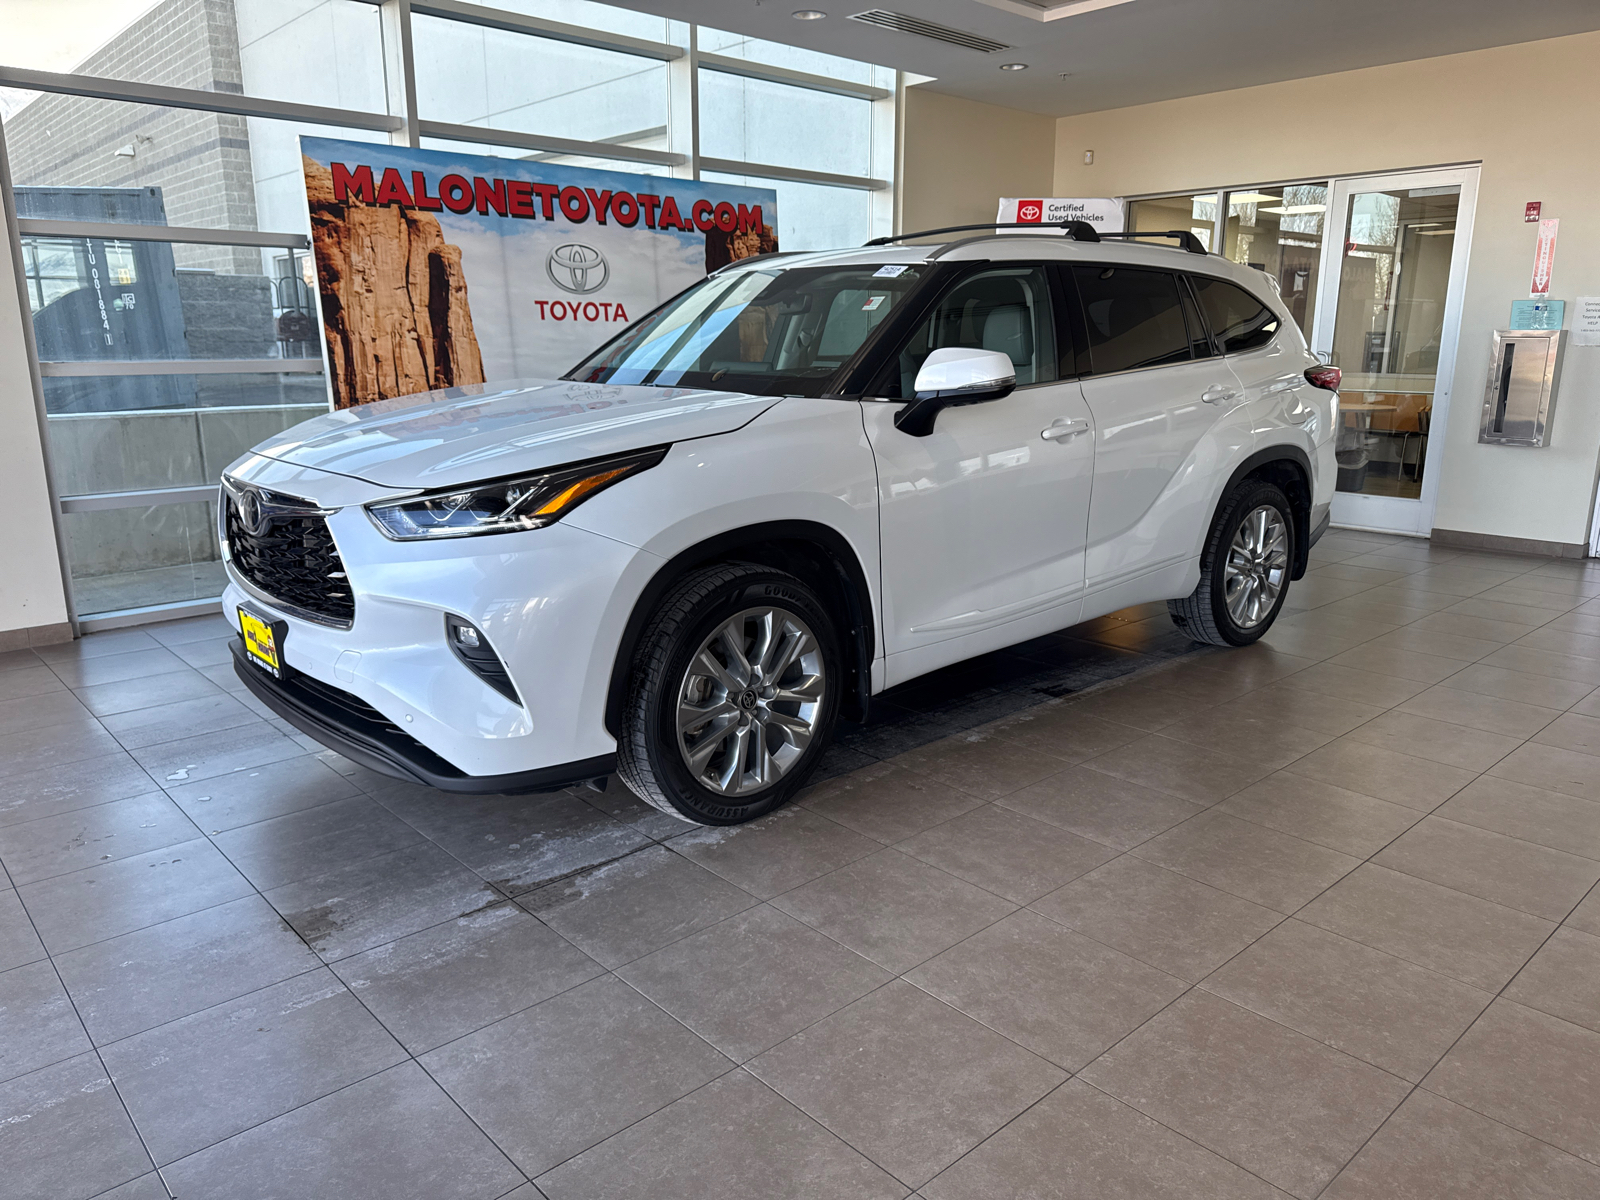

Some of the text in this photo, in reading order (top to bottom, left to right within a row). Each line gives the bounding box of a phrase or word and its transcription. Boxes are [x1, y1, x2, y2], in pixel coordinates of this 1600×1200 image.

[330, 162, 764, 235] MALONETOYOTA.COM
[1048, 204, 1084, 212] Certified
[1048, 214, 1104, 222] Used Vehicles
[534, 300, 629, 322] TOYOTA
